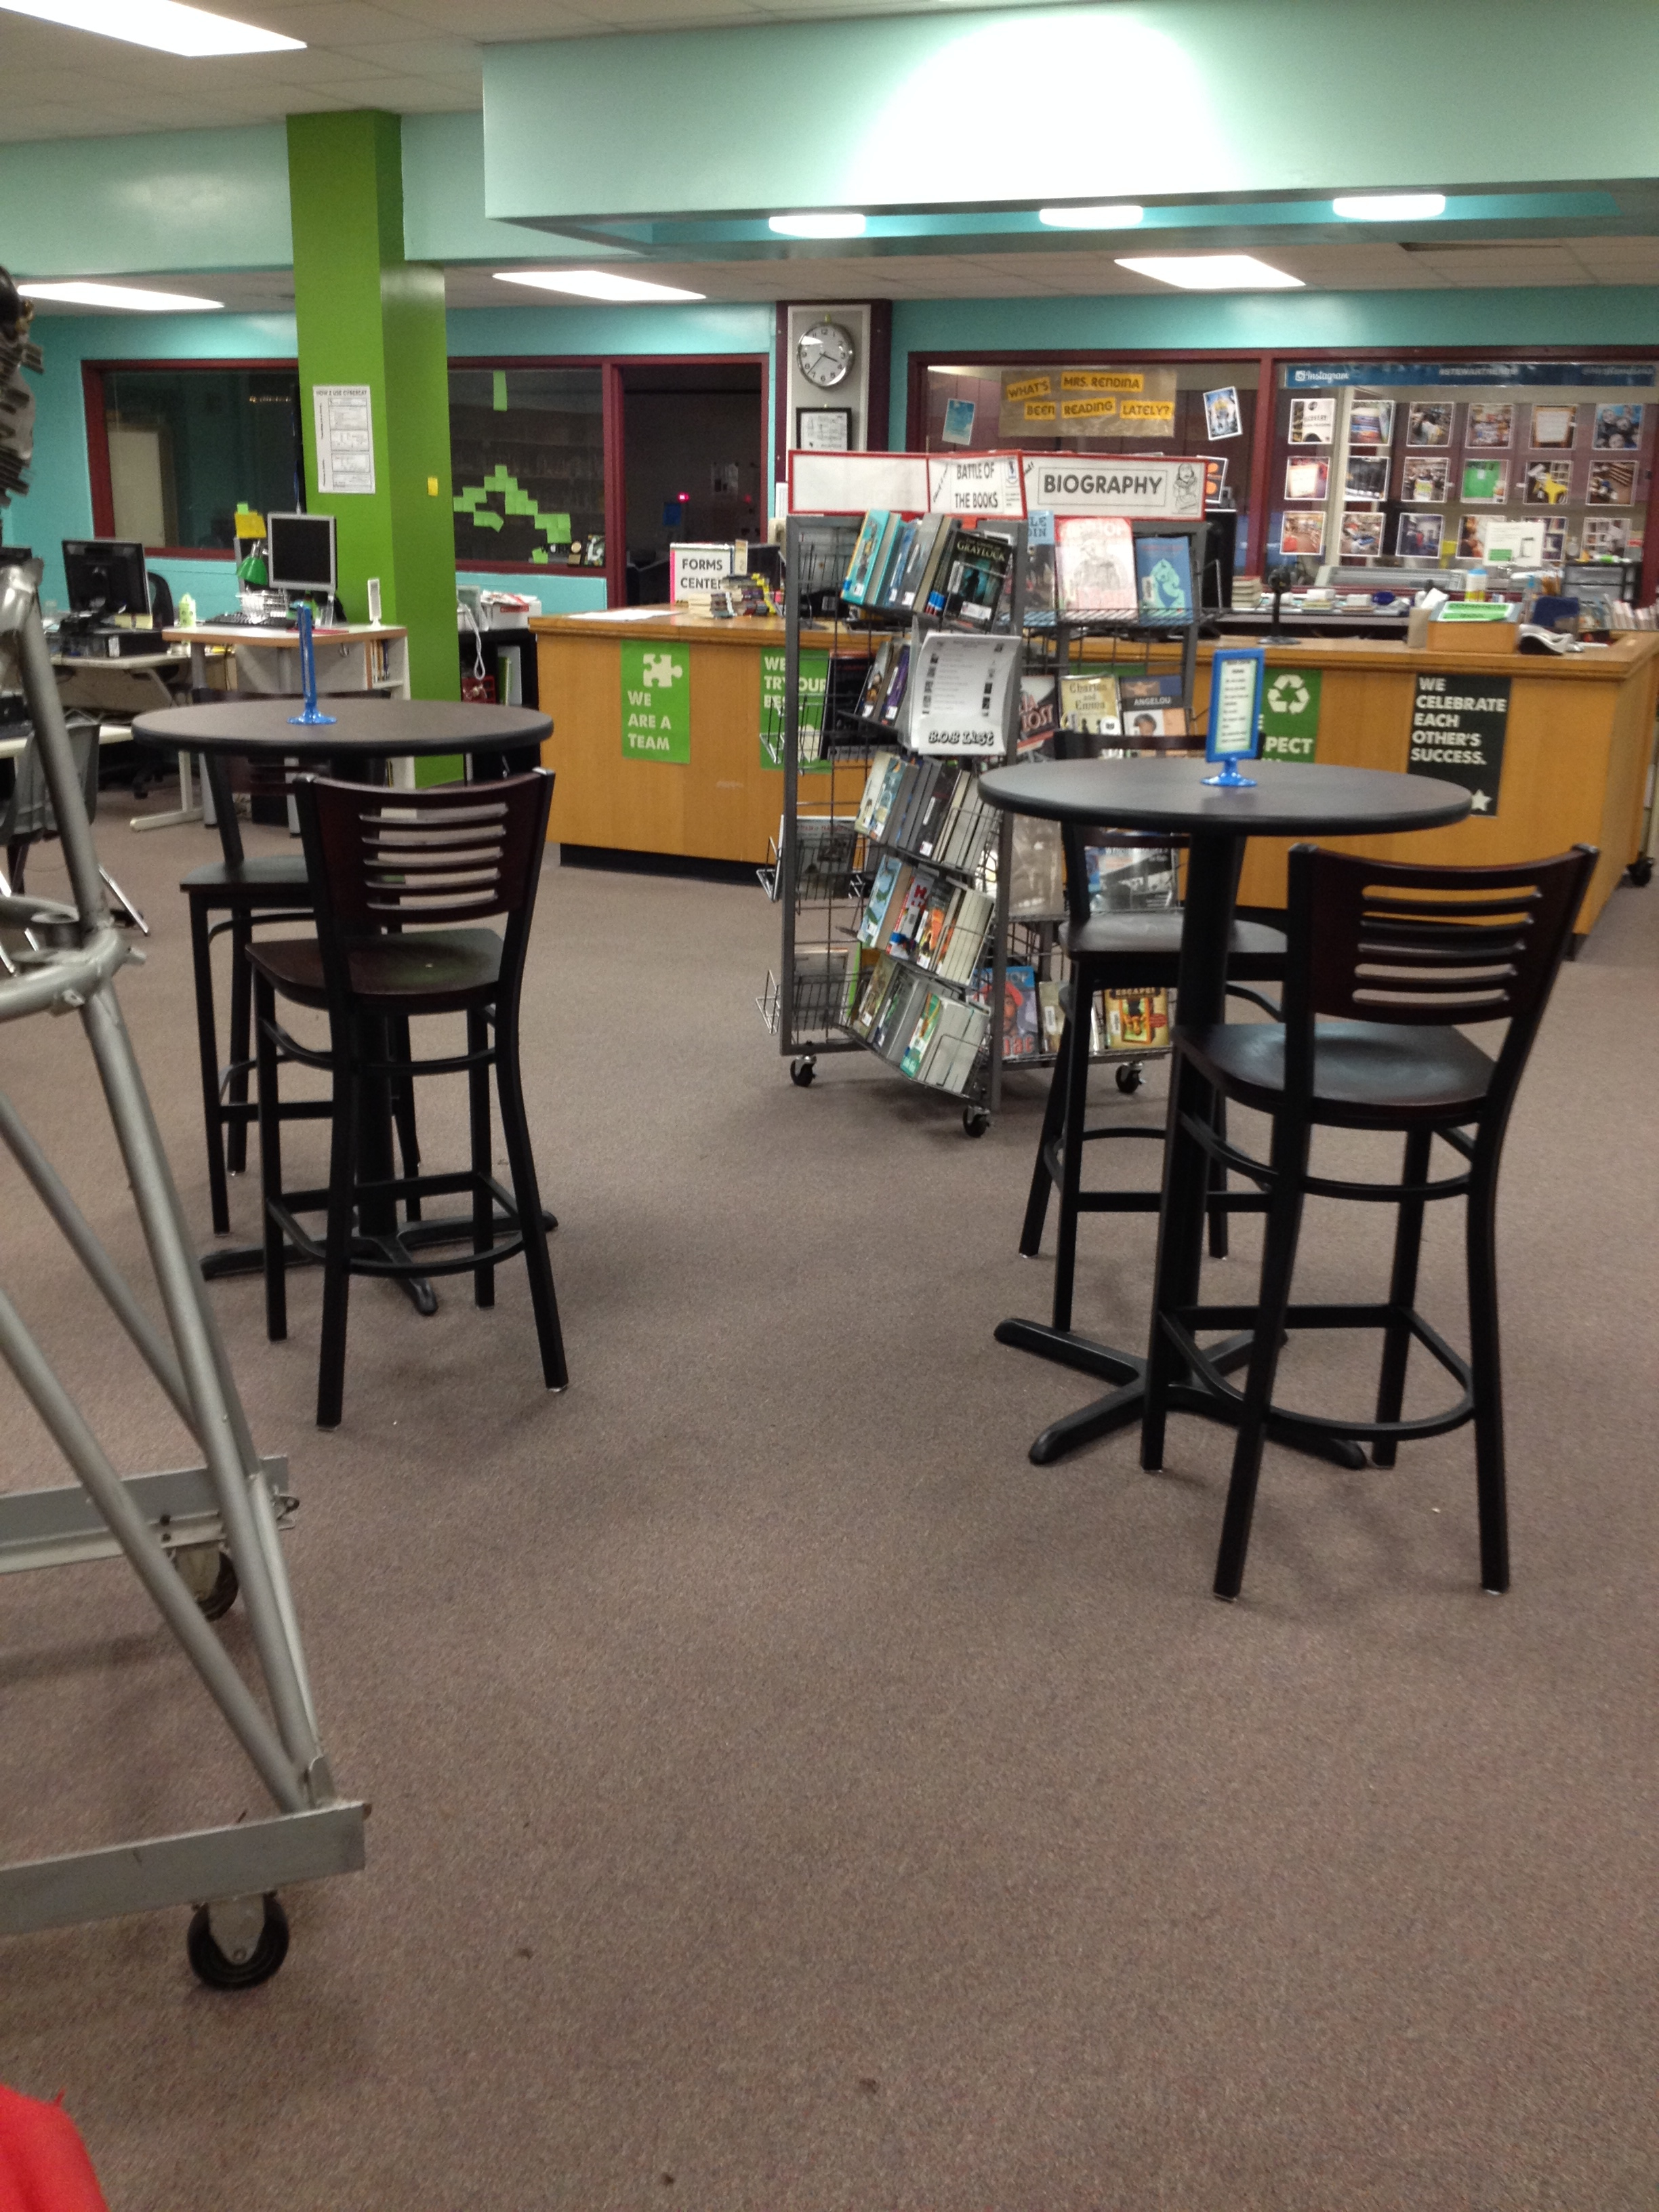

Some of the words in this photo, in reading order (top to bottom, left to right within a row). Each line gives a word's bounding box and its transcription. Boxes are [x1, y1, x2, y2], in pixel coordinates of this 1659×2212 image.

[1306, 371, 1349, 383] Instagram
[1008, 381, 1048, 398] WHAT'S
[1063, 377, 1087, 386] MRS.
[1091, 377, 1139, 388] RENDINA
[1027, 405, 1054, 415] BEEN
[1063, 401, 1113, 415] READING
[1122, 405, 1170, 415] LATELY?
[957, 464, 982, 479] BATTLE
[983, 462, 994, 478] OF
[1044, 474, 1162, 494] BIOGRAPHY
[955, 493, 970, 508] THE
[972, 492, 998, 508] BOOKS
[957, 542, 1005, 561] GRAYLOCK
[682, 558, 722, 571] FORMS
[764, 656, 785, 672] WE
[798, 677, 826, 692] OUR
[1418, 677, 1446, 692] WE
[628, 691, 651, 707] WE
[1075, 701, 1105, 711] Emma
[1134, 697, 1170, 706] ANGELOU
[1416, 695, 1508, 712] CELEBRATE
[628, 714, 655, 729] ARE
[661, 716, 672, 730] A
[1021, 704, 1053, 732] LOST
[1413, 712, 1460, 728] EACH
[628, 733, 670, 750] TEAM
[962, 731, 994, 746] List
[1265, 736, 1313, 754] PECT
[1412, 730, 1482, 747] OTHER'S
[1410, 747, 1488, 765] SUCCESS.
